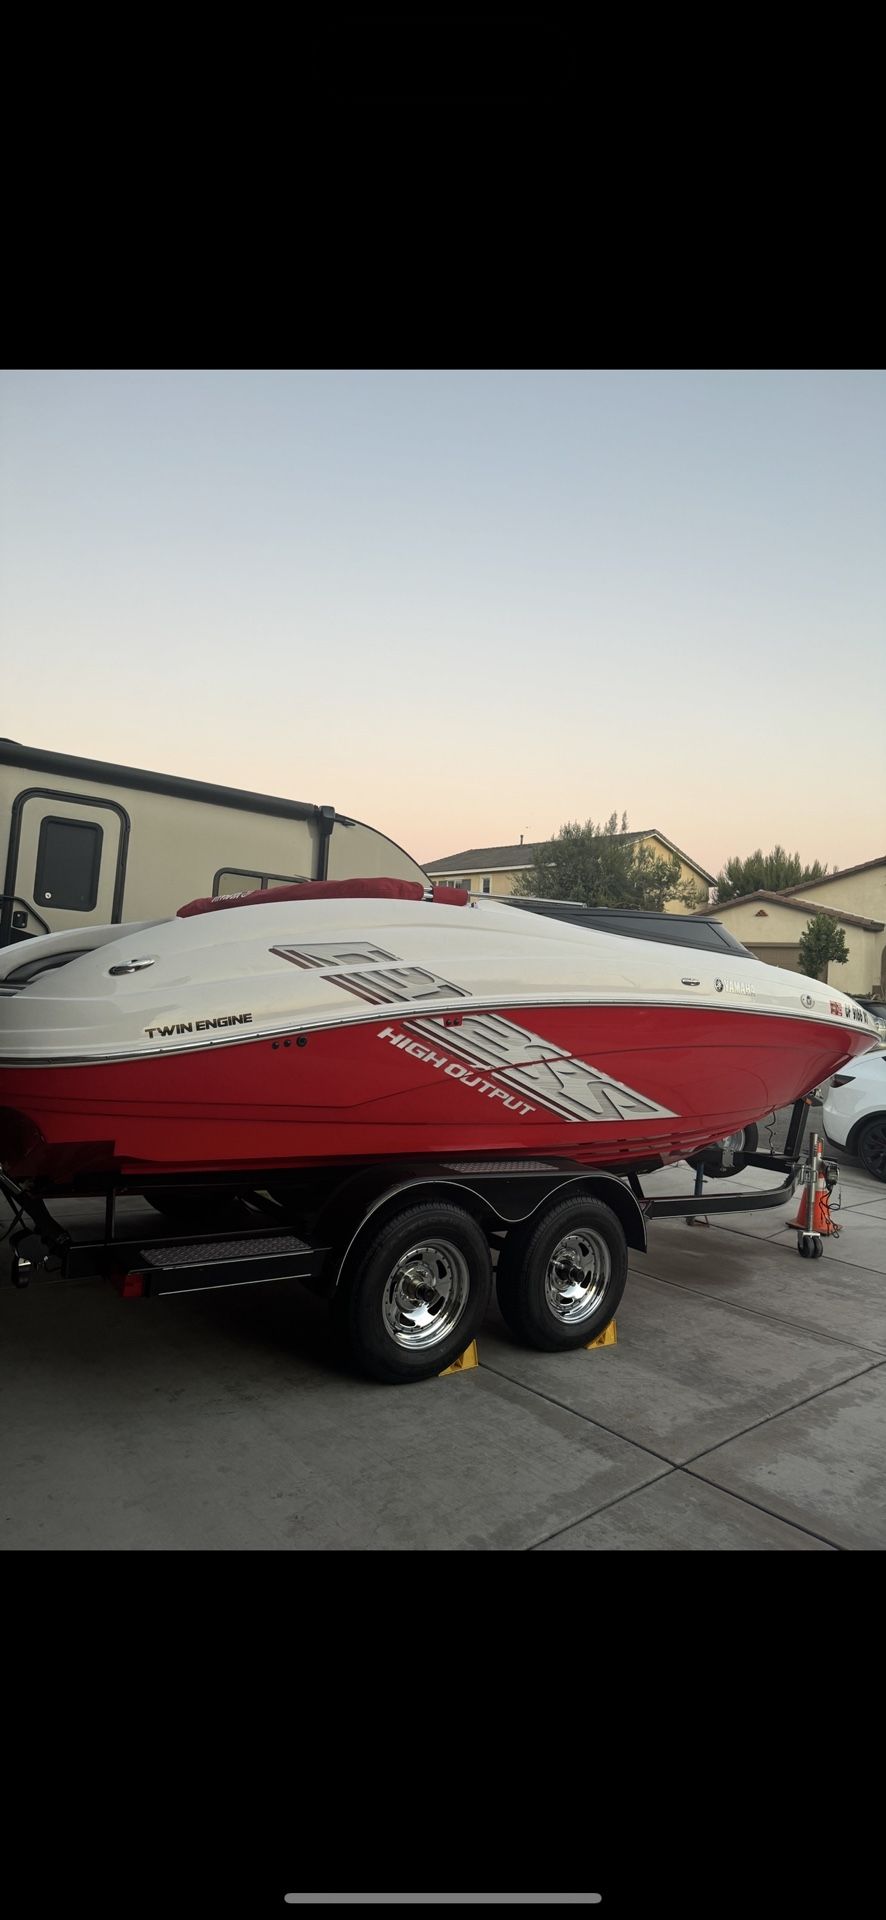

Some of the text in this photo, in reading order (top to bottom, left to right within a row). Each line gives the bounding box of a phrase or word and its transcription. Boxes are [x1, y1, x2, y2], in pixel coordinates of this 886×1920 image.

[145, 1013, 253, 1039] TWIN ENGINE
[377, 1026, 536, 1116] HIGH OUTPUT
